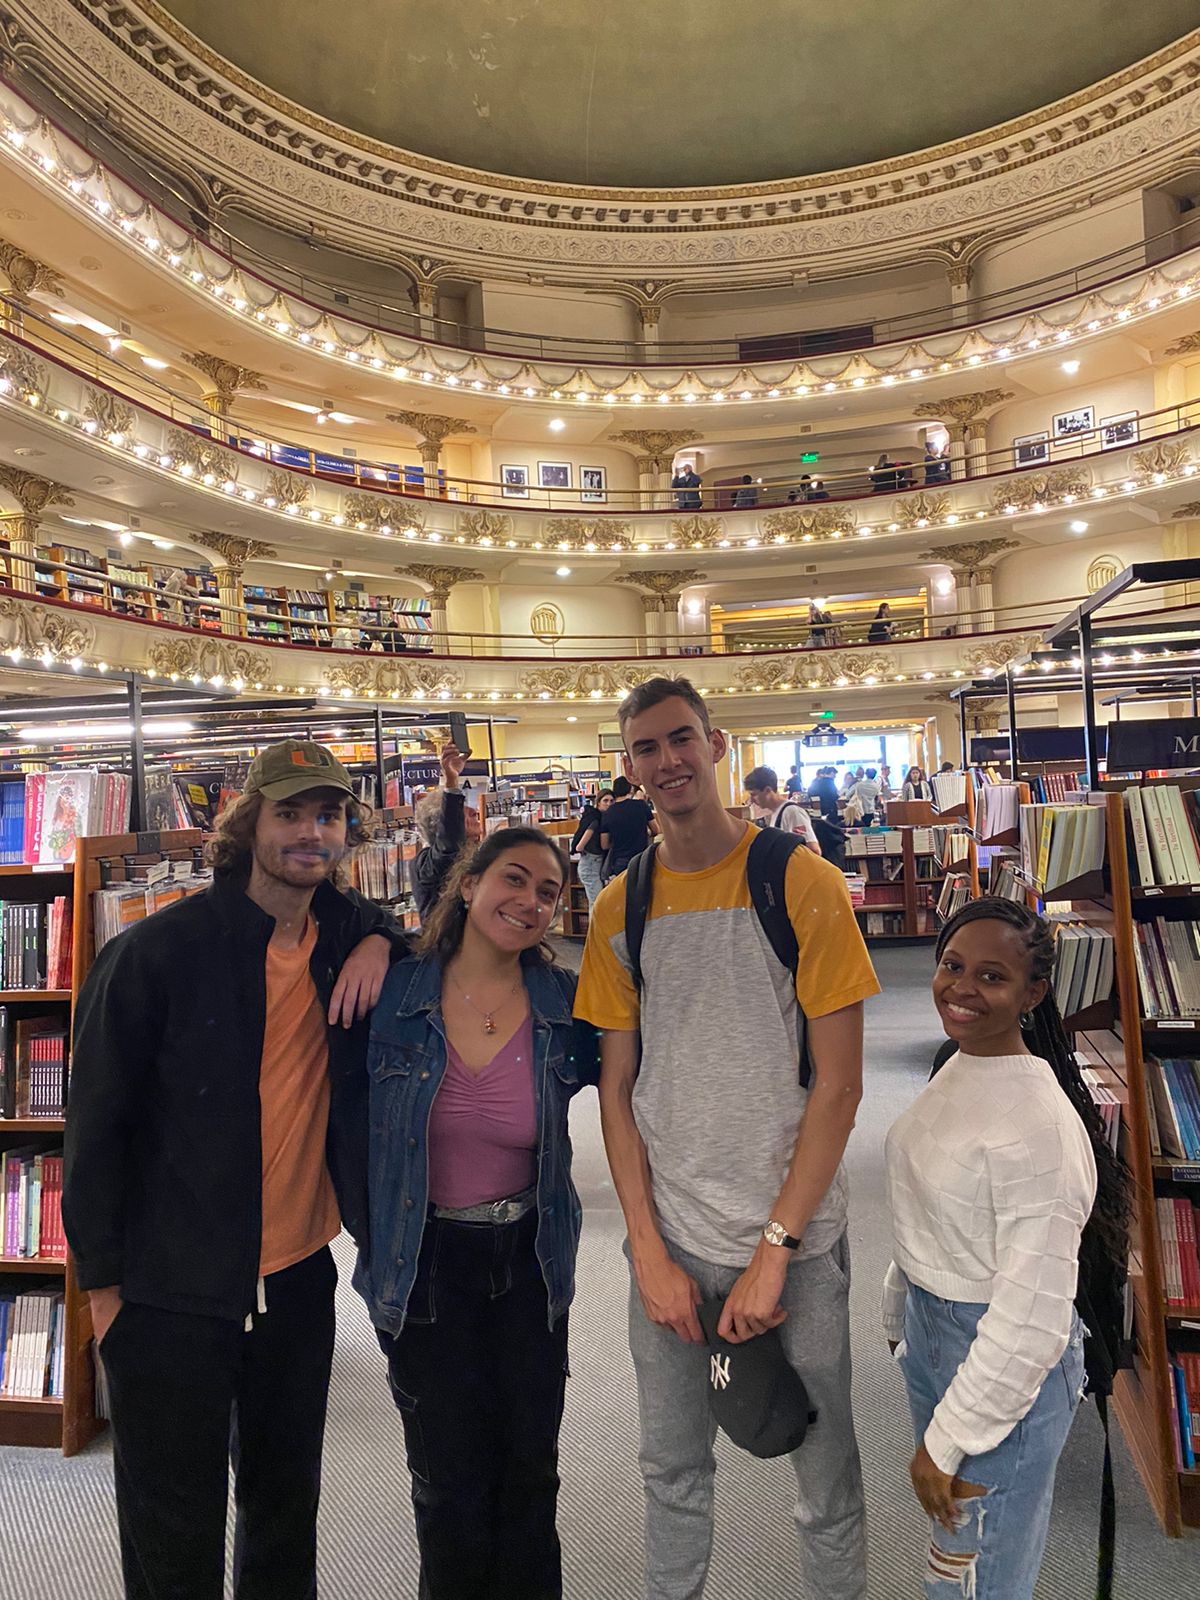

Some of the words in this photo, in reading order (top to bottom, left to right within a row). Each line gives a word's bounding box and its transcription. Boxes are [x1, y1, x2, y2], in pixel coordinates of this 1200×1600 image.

[1173, 735, 1200, 753] M
[291, 751, 331, 768] U
[710, 1353, 731, 1390] NY
